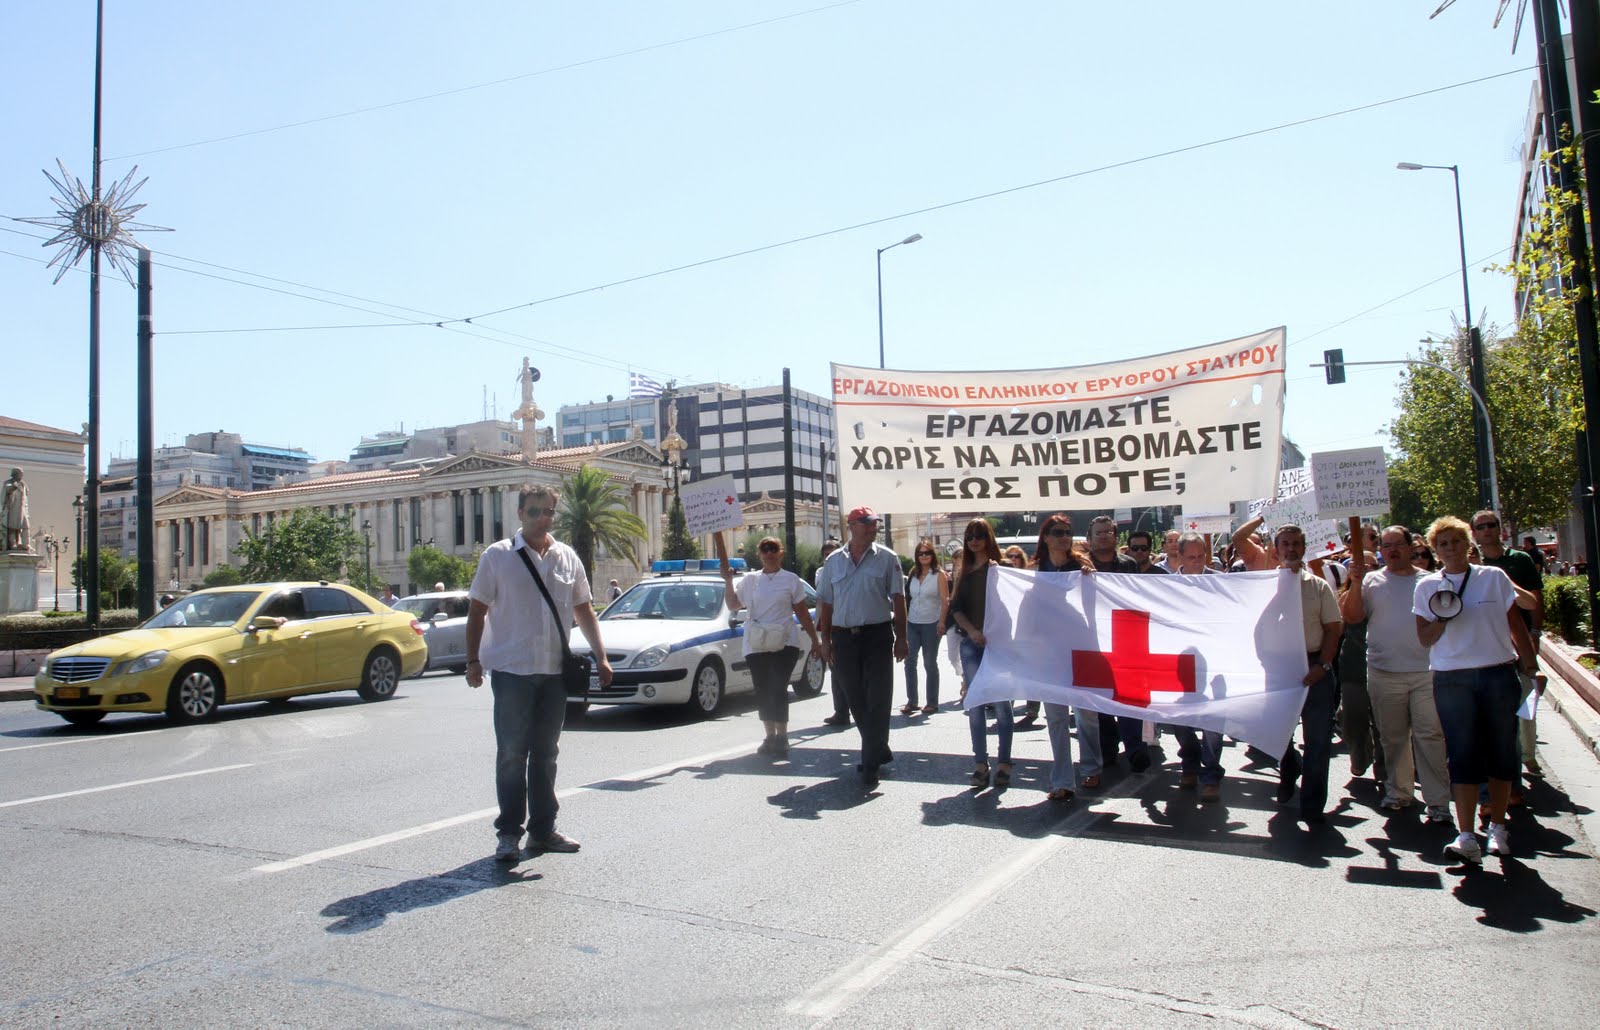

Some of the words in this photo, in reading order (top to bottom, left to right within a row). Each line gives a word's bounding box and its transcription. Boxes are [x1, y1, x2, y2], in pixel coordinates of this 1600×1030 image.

[833, 378, 960, 399] ΕΡΓΑΖΟΜΕΝΟΙ
[964, 381, 1079, 399] ΕΛΛΗΝΙΚΟΥ
[1085, 366, 1179, 394] ΕΡΥΘΡΟΥ
[1185, 344, 1279, 377] ΣΤΑΥΡΟΥ
[926, 395, 1172, 438] ΕΡΓΑΖΟΜΑΣΤΕ
[851, 446, 945, 470] ΧΩΡΙΣ
[954, 443, 1002, 468] ΝΑ
[1009, 421, 1263, 467] ΑΜΕΙΒΟΜΑΣΤΕ
[930, 475, 1021, 500] ΕΩΣ
[1037, 466, 1186, 498] ΠΟΤΕ;
[1322, 492, 1342, 501] ΚΑΙ
[1349, 487, 1388, 499] ΕΜΕΙΣ
[1336, 479, 1375, 490] ΒΡΟΥΝΕ
[1287, 510, 1306, 520] ΤΟΥ
